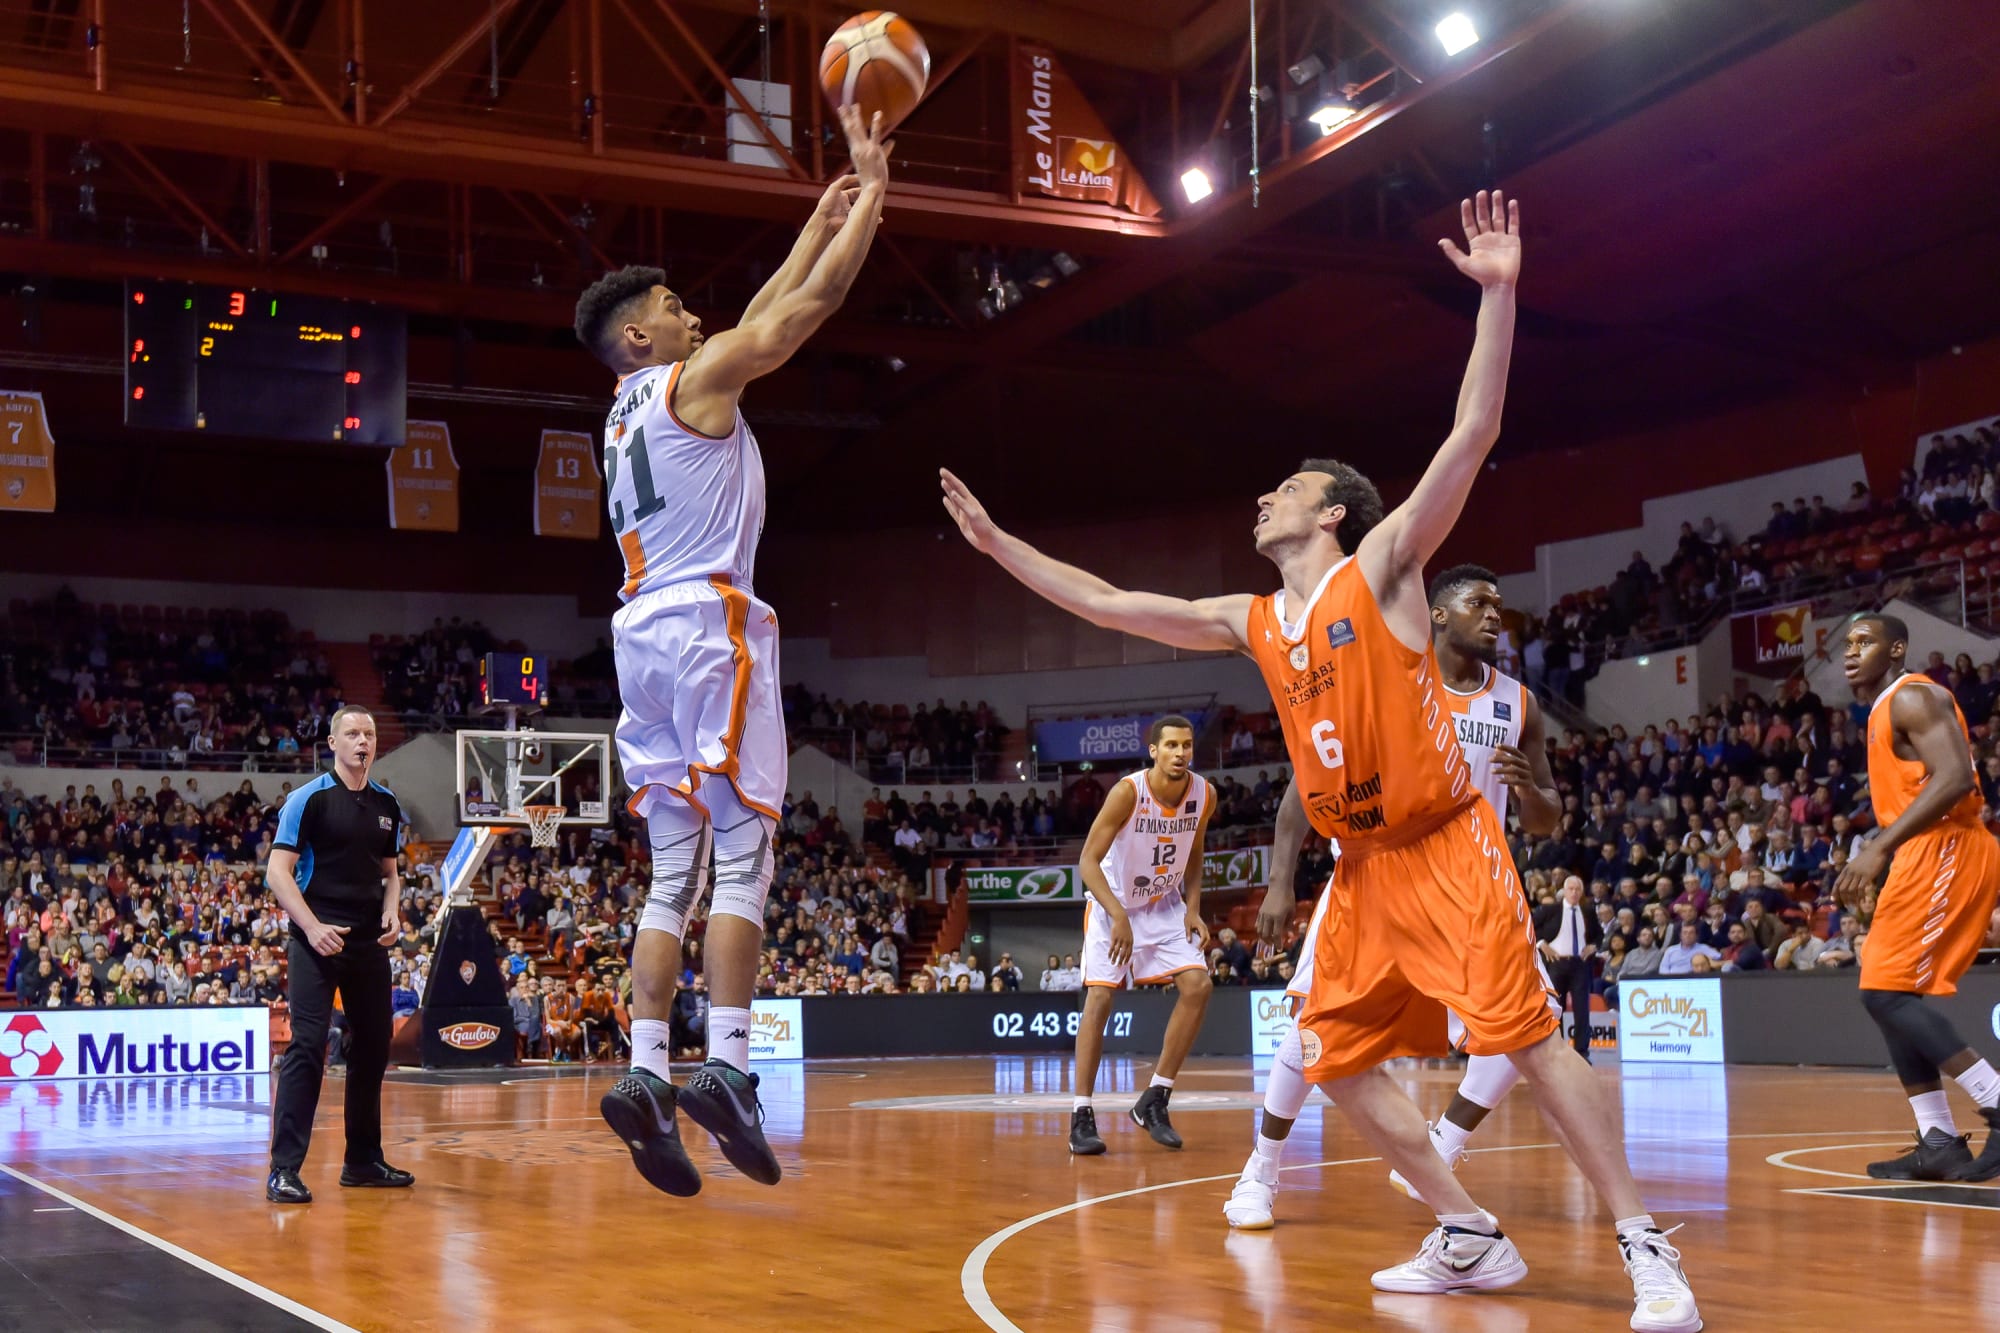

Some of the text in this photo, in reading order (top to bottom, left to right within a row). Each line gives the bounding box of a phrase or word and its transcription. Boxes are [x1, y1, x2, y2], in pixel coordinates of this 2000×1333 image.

[1026, 55, 1053, 189] Le Mans
[1060, 168, 1077, 183] Le
[229, 292, 245, 316] 3
[200, 337, 214, 356] 2
[8, 421, 24, 444] 7
[411, 447, 435, 469] 11
[555, 458, 580, 479] 13
[604, 424, 667, 534] 21
[1760, 646, 1774, 661] Le
[522, 657, 534, 675] 0
[1676, 655, 1687, 685] E
[521, 677, 538, 700] 4
[1288, 677, 1335, 707] RISHON
[1086, 720, 1140, 740] ouest
[1459, 718, 1508, 748] SARTHE
[1080, 737, 1140, 755] france
[1310, 719, 1344, 769] 6
[1135, 818, 1145, 833] LE
[1169, 817, 1199, 834] SARTHE
[1151, 844, 1177, 867] 12
[1629, 988, 1708, 1037] Century 21
[450, 1026, 497, 1045] Gaulois
[773, 1020, 790, 1041] 21
[993, 1013, 1025, 1037] 02
[1030, 1012, 1060, 1037] 43
[1114, 1012, 1133, 1037] 27
[78, 1029, 254, 1075] Mutuel
[1650, 1041, 1692, 1055] Harmony
